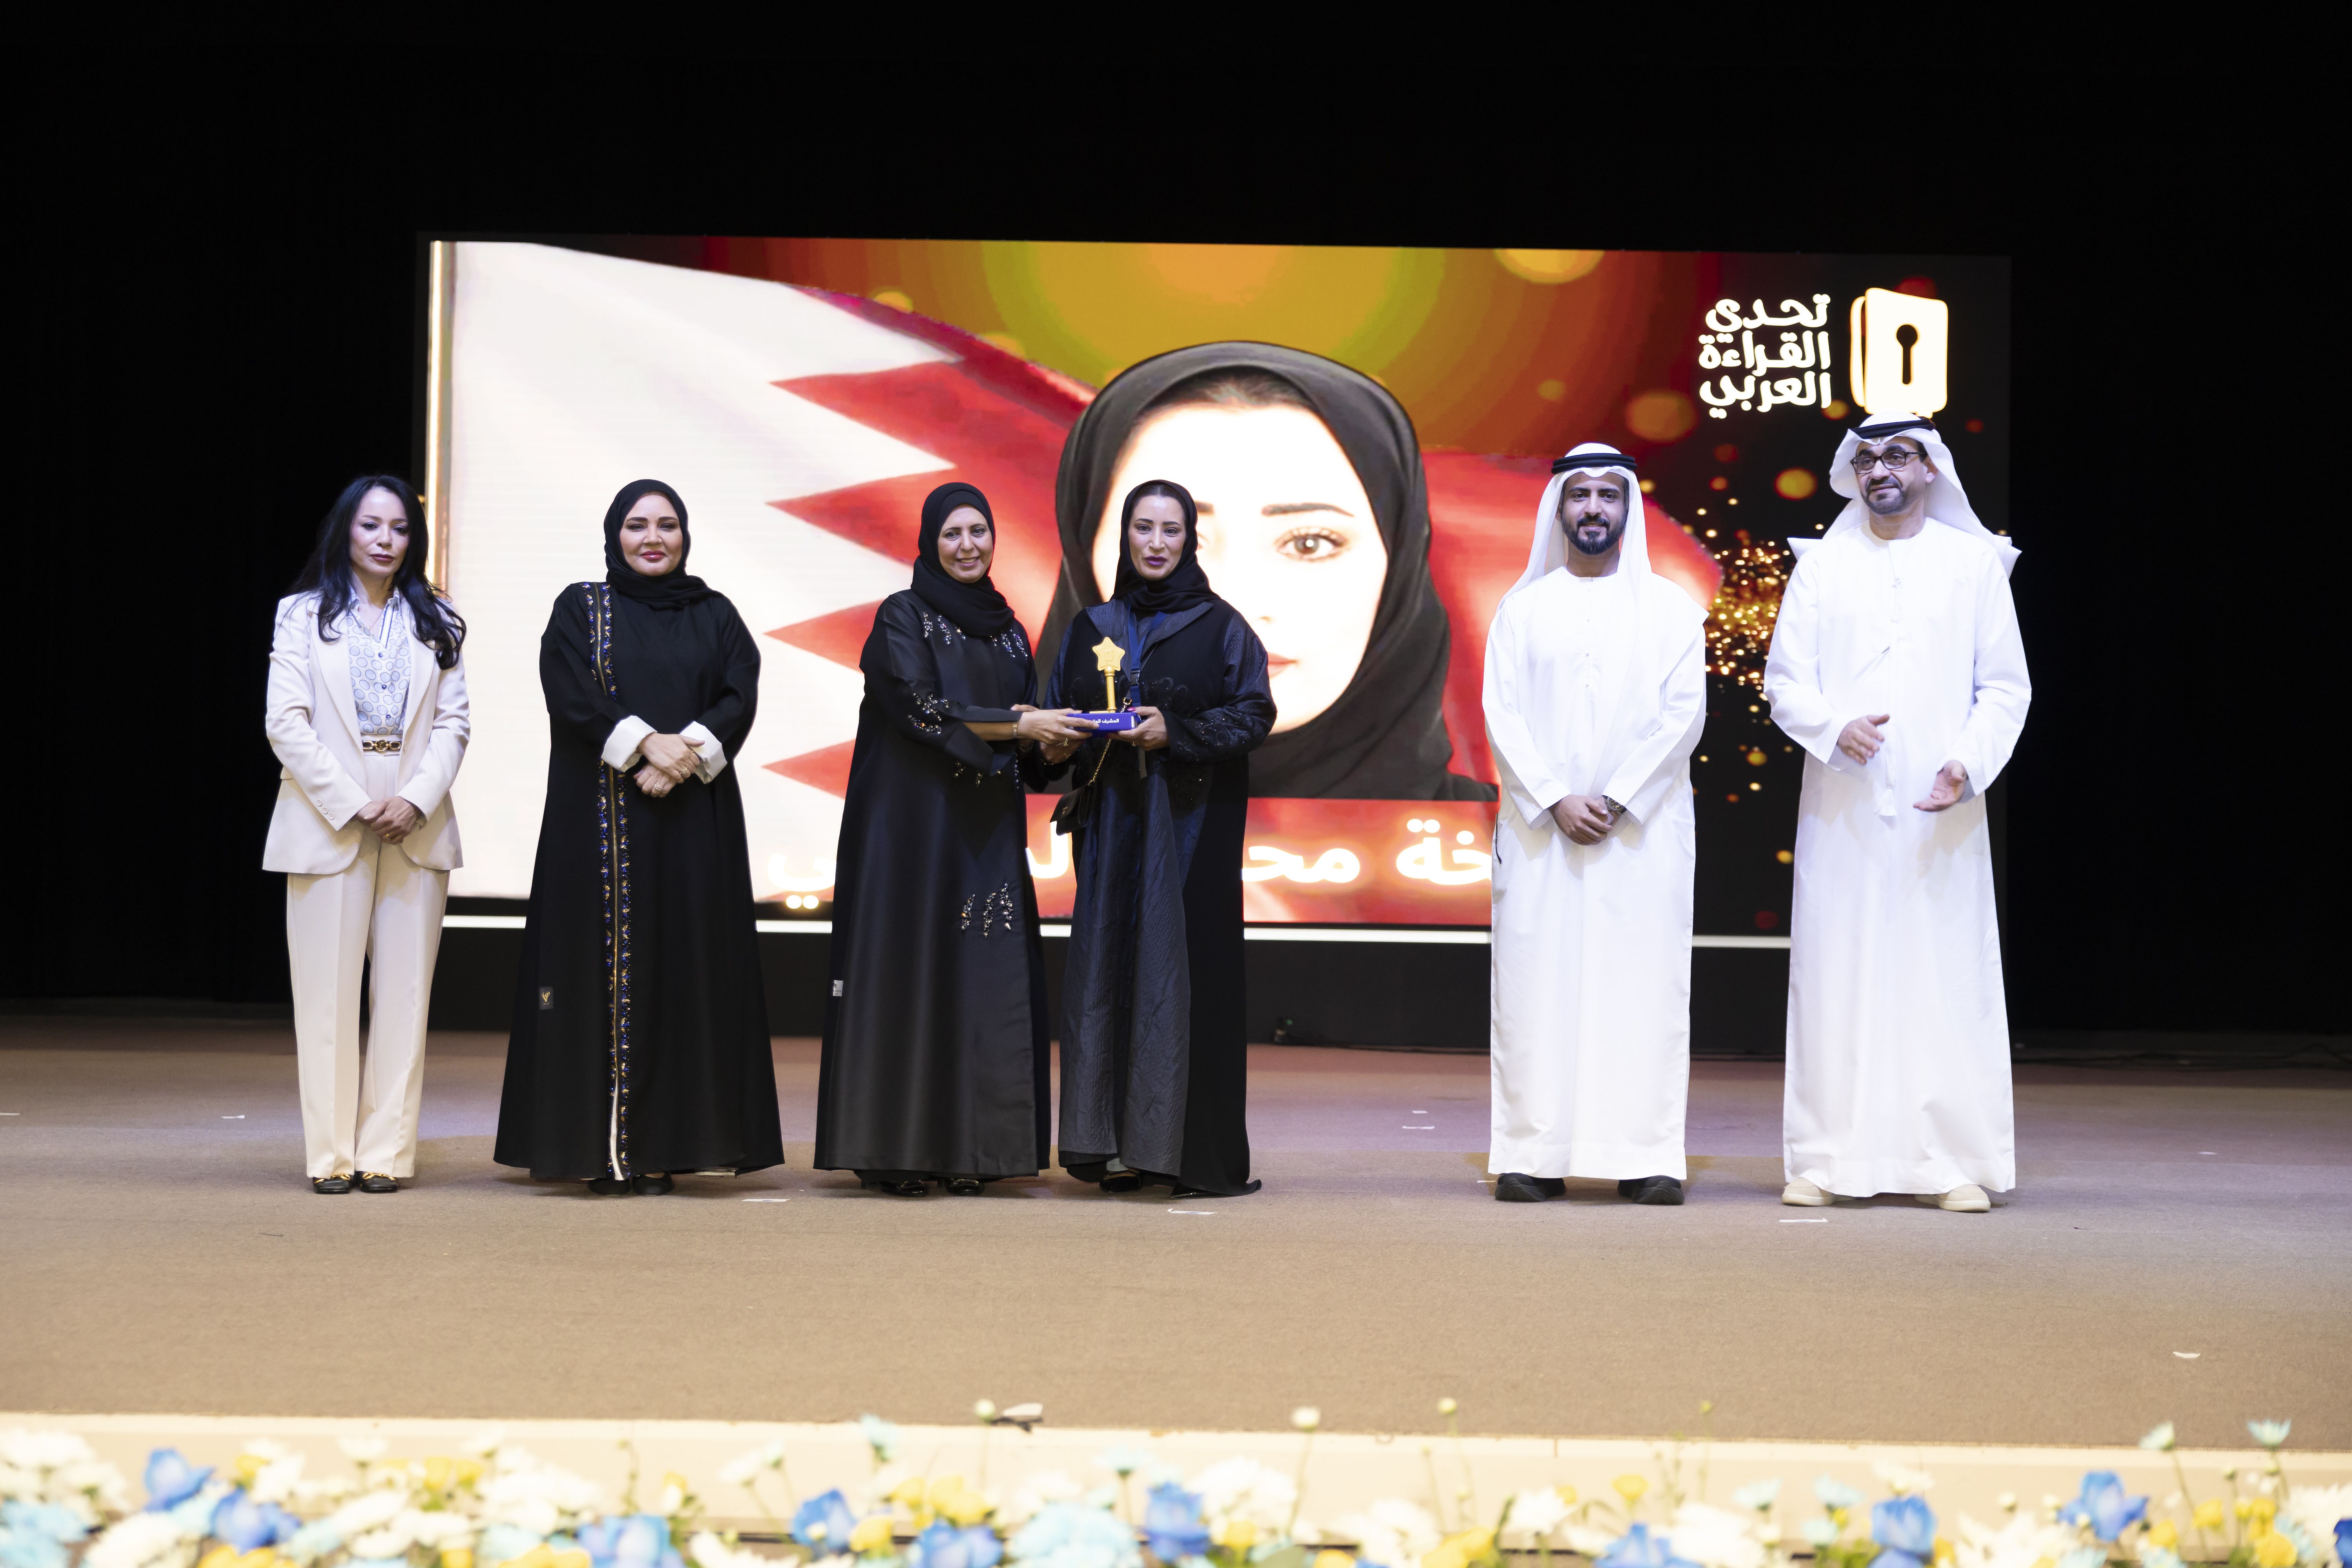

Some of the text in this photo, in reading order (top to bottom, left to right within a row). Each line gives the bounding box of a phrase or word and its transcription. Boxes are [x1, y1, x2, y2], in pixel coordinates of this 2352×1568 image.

[1705, 294, 1831, 343] تحدي
[1699, 330, 1831, 377] القراءة
[1699, 371, 1831, 419] العربي
[1242, 846, 1360, 883] مح
